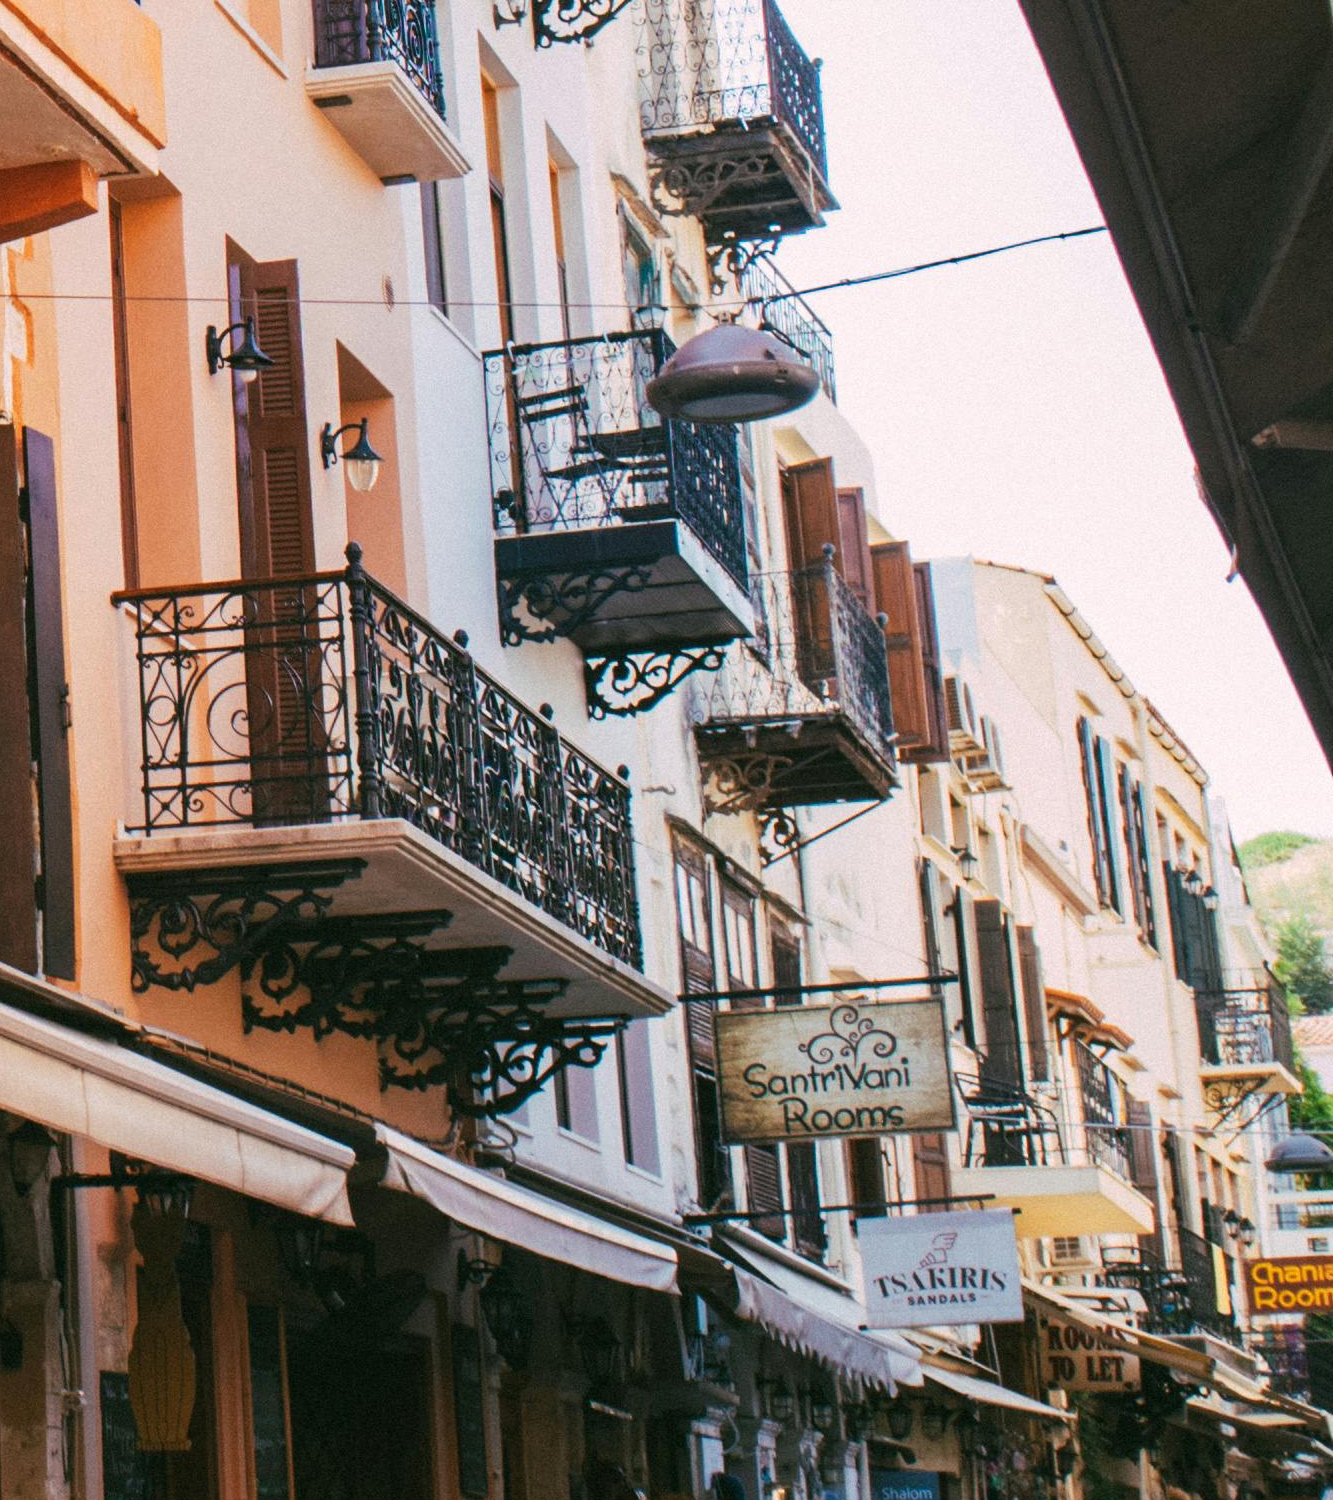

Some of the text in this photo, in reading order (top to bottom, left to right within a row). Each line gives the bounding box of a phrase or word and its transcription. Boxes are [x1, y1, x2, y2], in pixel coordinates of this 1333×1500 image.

[778, 1097, 905, 1133] Rooms
[873, 1267, 1007, 1298] TSAKIRIS
[907, 1293, 977, 1306] SANDALS
[1048, 1356, 1125, 1382] TO LET
[882, 1487, 933, 1500] Shalom
